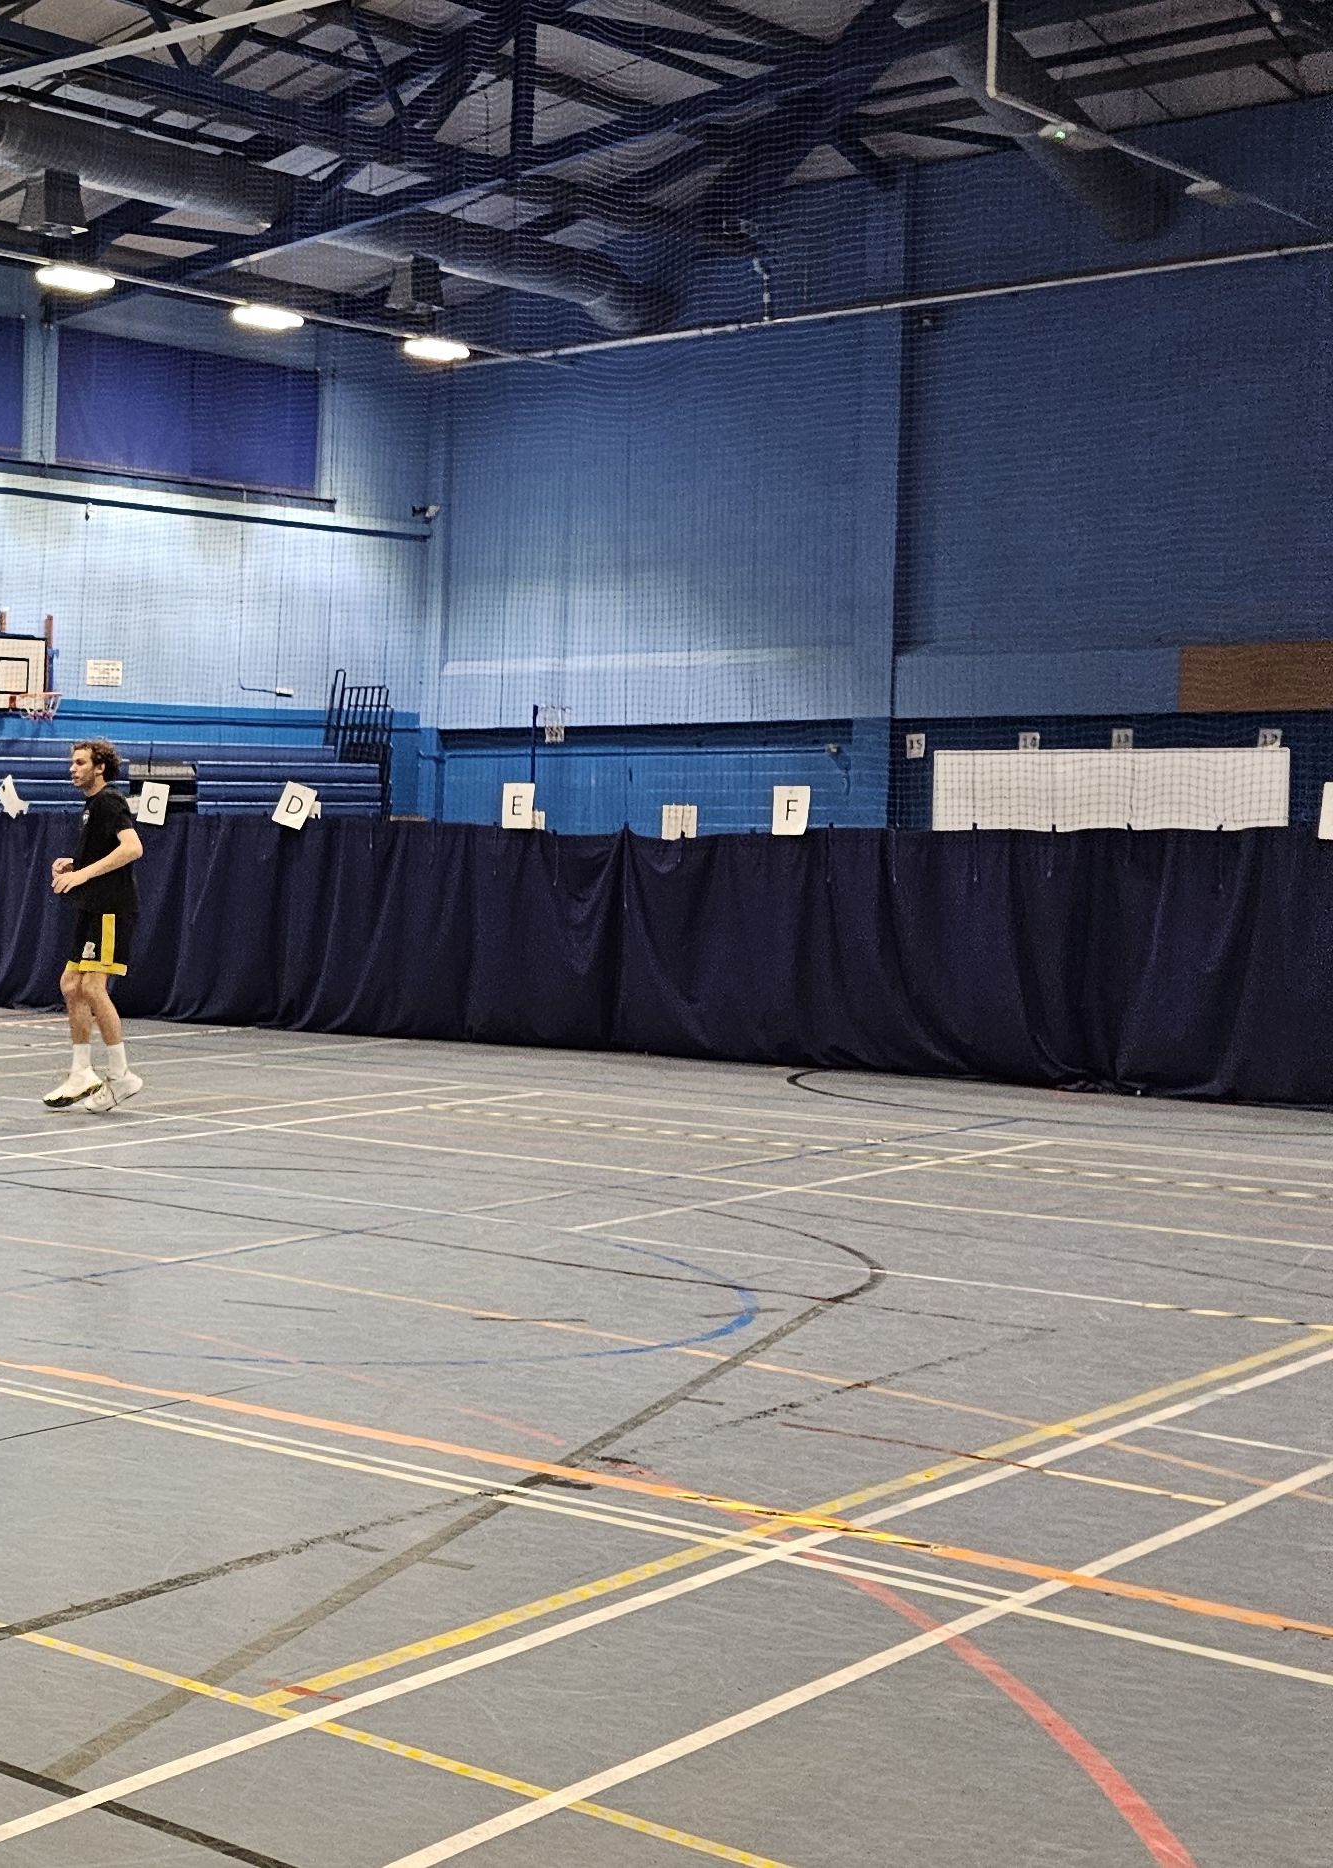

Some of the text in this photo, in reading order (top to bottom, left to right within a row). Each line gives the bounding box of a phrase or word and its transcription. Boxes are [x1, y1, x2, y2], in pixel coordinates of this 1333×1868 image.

[147, 796, 160, 814] C
[285, 795, 303, 815] D
[512, 795, 523, 816] E
[786, 799, 798, 821] F
